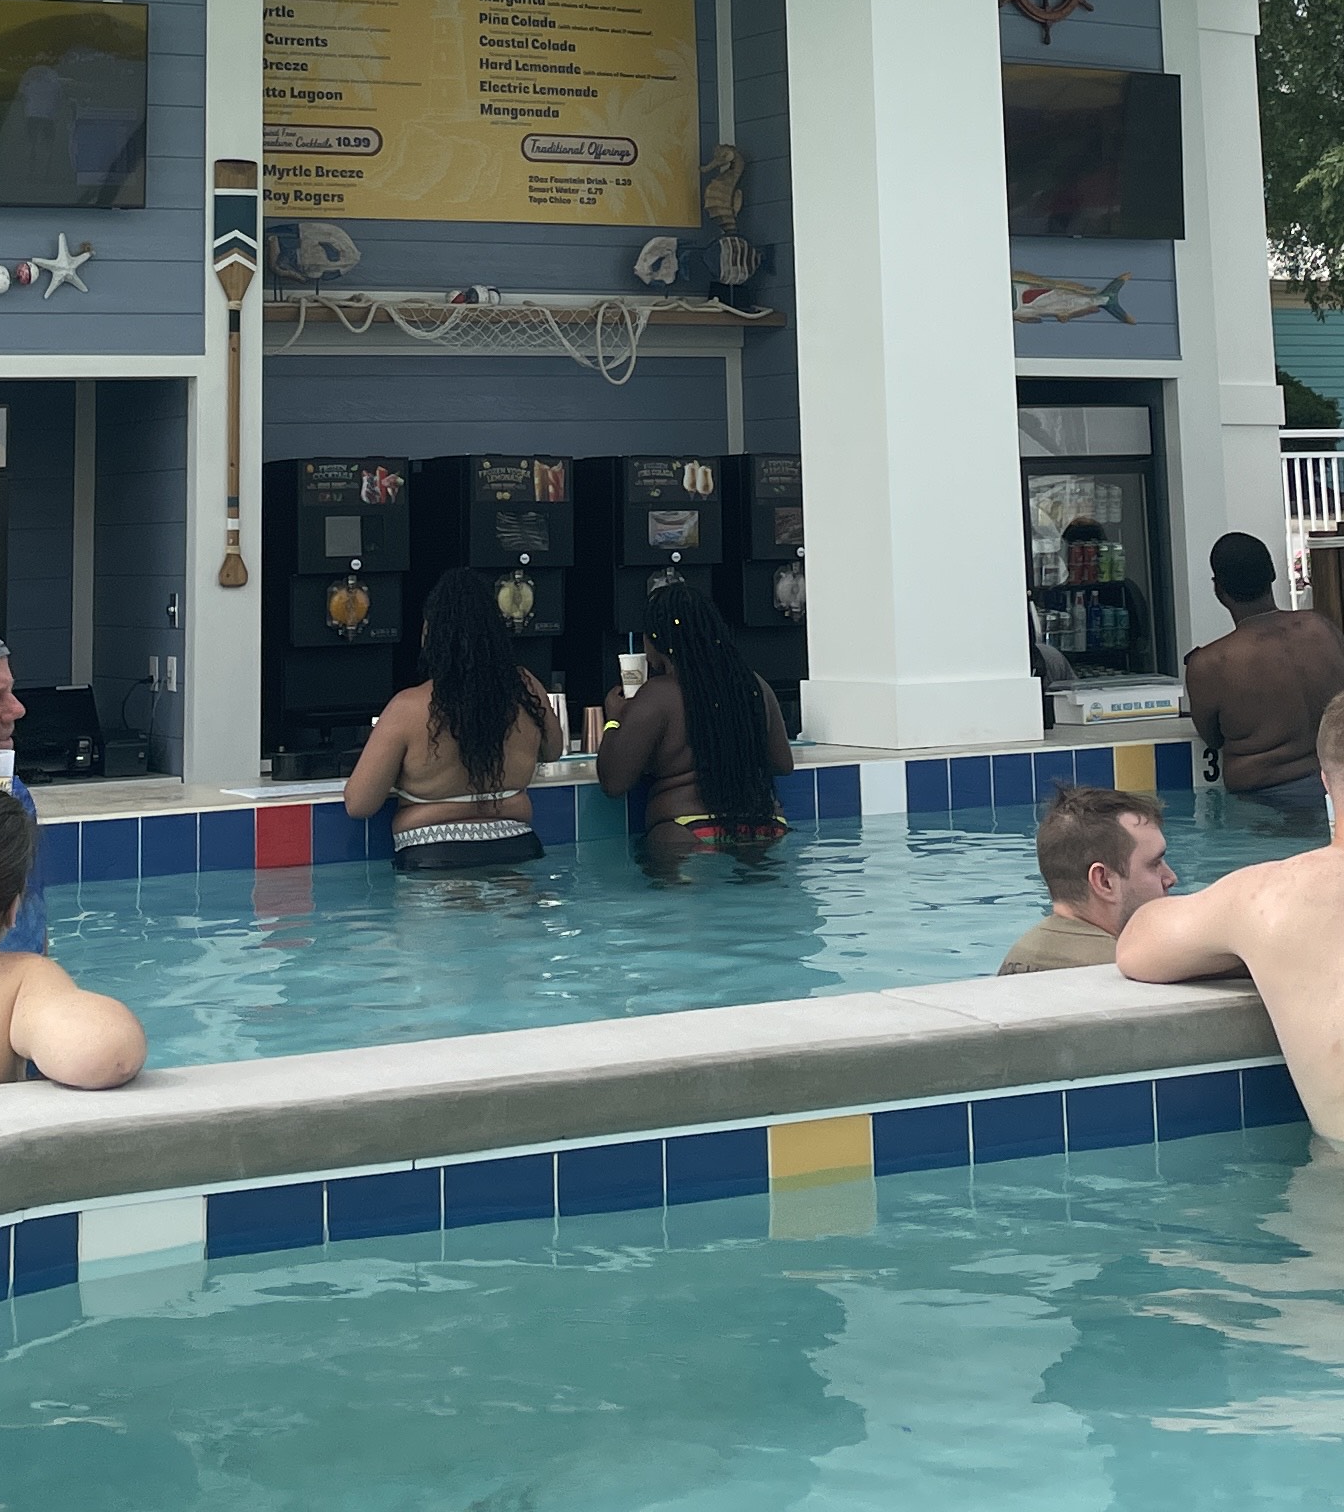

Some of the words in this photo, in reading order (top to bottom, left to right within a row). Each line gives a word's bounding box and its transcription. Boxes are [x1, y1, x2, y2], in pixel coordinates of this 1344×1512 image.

[479, 12, 509, 27] Piña
[511, 14, 557, 29] Colada
[265, 32, 329, 47] Currents
[479, 34, 529, 50] Coastal
[531, 38, 577, 53] Colada
[479, 57, 513, 71] Hard
[515, 59, 582, 75] Lemonade
[263, 87, 287, 99] tto
[290, 86, 343, 103] Lagoon
[479, 80, 531, 95] Electric
[532, 83, 599, 98] Lemonade
[480, 103, 560, 120] Mangonada
[335, 136, 371, 149] 10.99
[530, 139, 586, 155] Traditional
[587, 141, 632, 161] Offerings
[263, 164, 312, 180] Myrtle
[315, 165, 364, 179] Breeze
[549, 176, 585, 185] Fountain
[586, 177, 608, 186] Drink
[263, 189, 290, 205] Roy
[294, 190, 344, 205] Rogers
[528, 185, 554, 194] Smart
[555, 186, 580, 195] Water
[549, 196, 571, 204] Chico
[1203, 748, 1220, 782] 3
